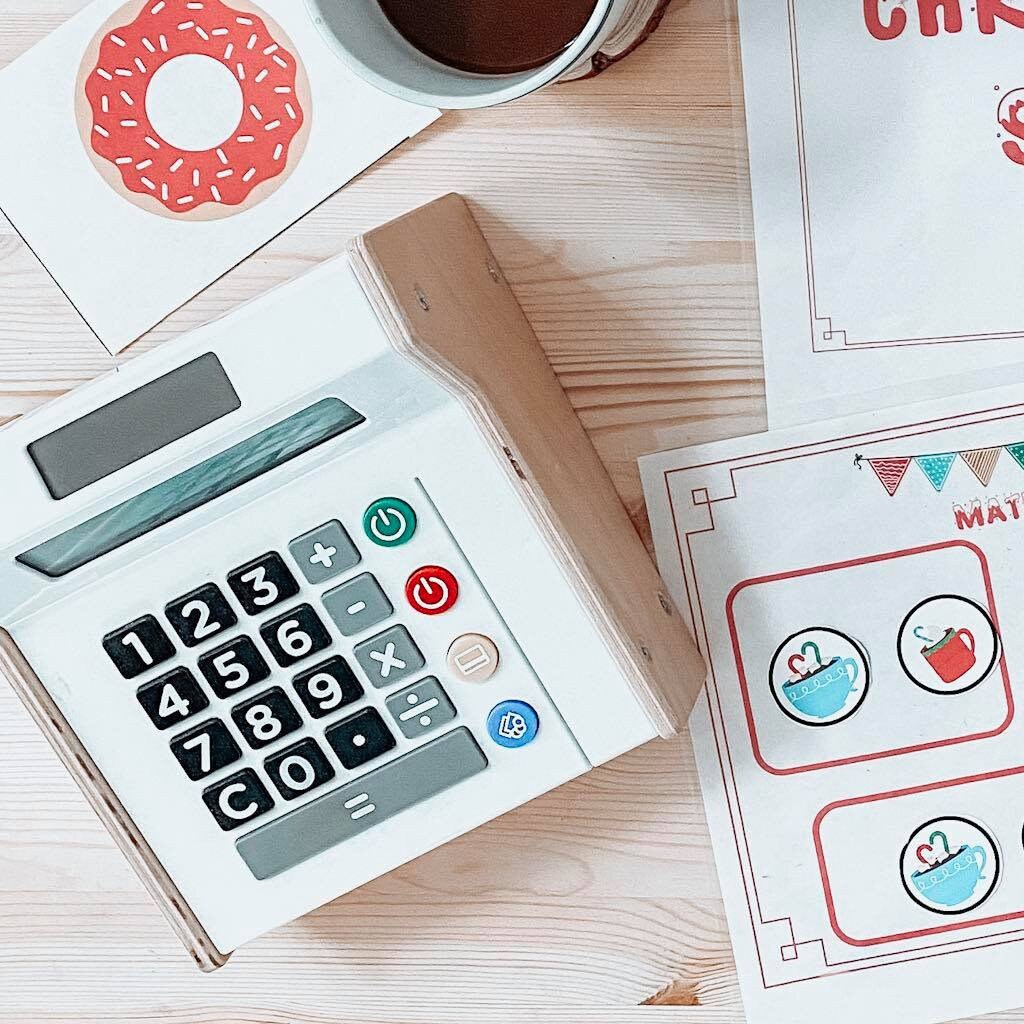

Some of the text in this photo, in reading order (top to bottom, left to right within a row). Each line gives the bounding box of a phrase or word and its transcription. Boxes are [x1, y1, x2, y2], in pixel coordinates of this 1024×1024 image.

[121, 632, 153, 665] 1
[180, 601, 221, 639] 2
[241, 566, 279, 606] 3
[158, 684, 190, 720] 4
[213, 650, 250, 689] 5
[276, 619, 313, 657] 6
[183, 733, 211, 772] 7
[245, 705, 282, 741] 8
[307, 673, 343, 709] 9
[218, 783, 258, 820] C
[279, 756, 316, 791] 0
